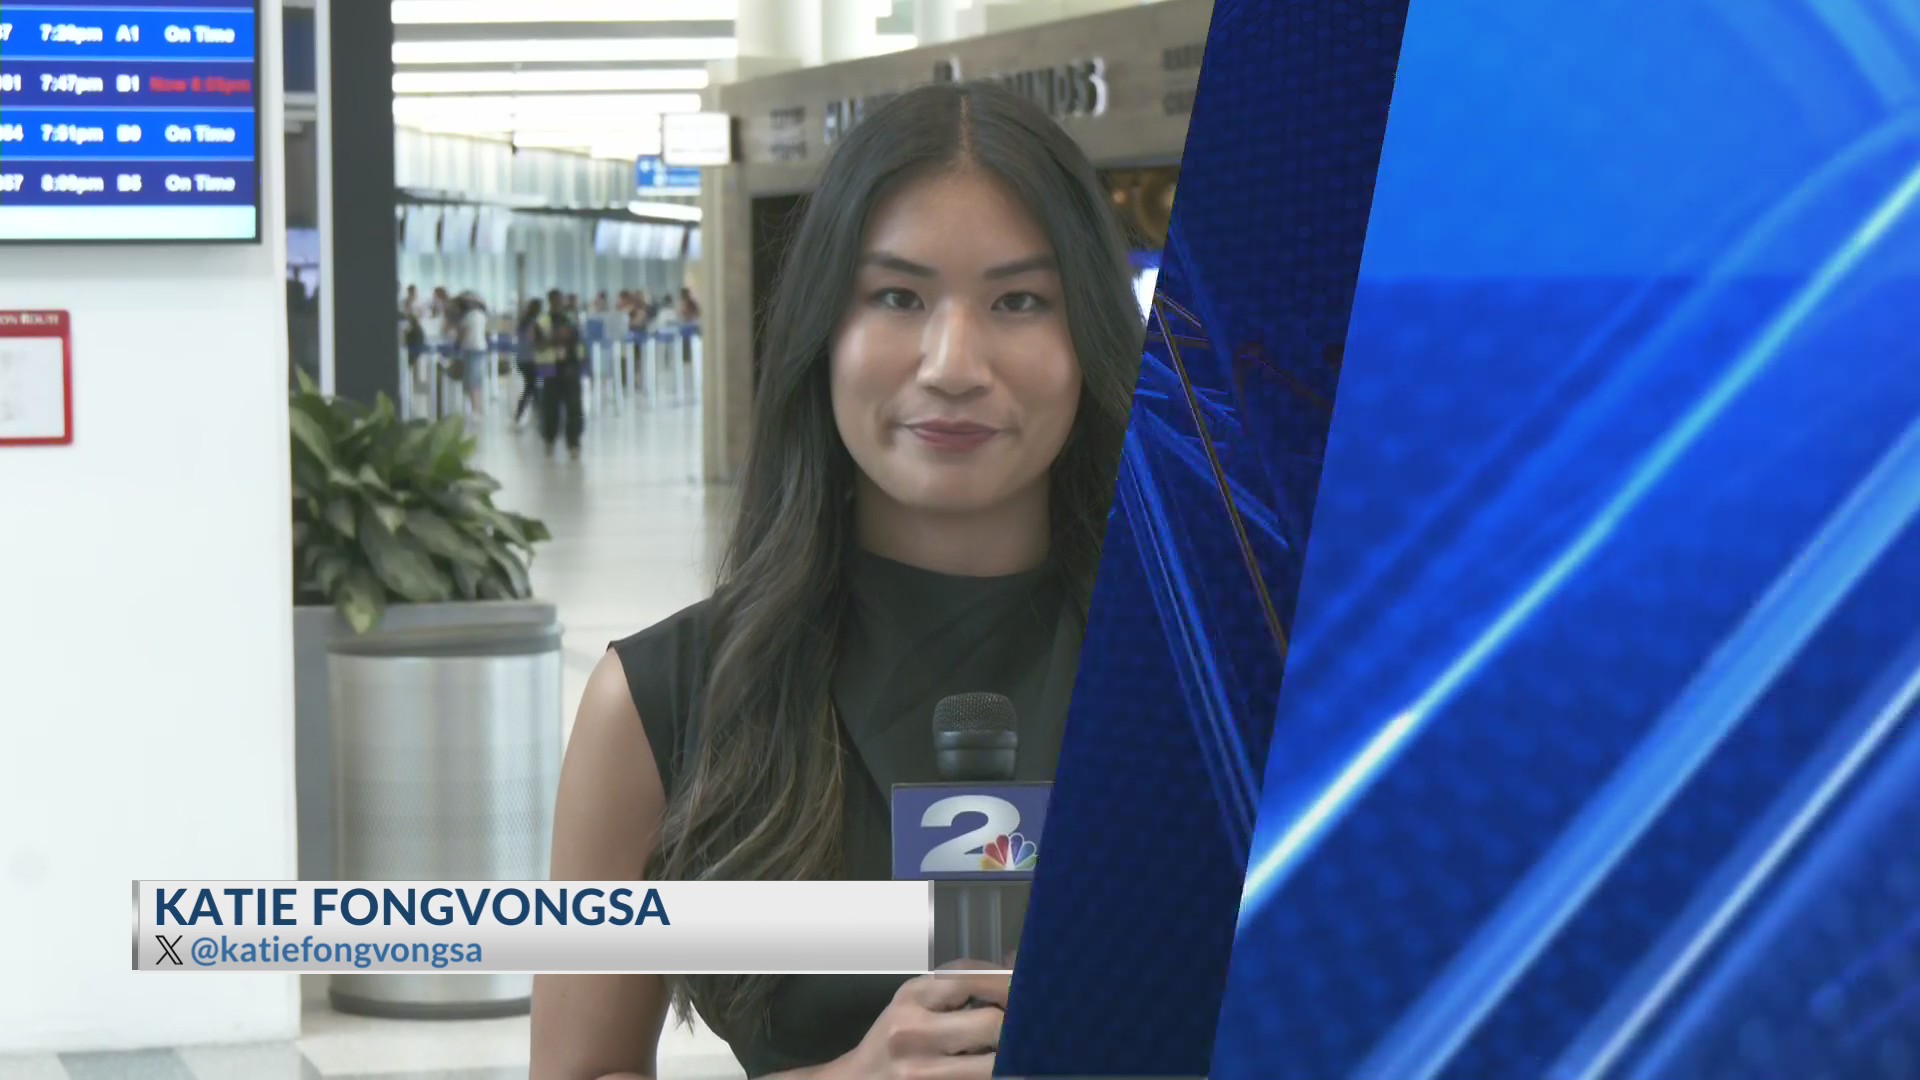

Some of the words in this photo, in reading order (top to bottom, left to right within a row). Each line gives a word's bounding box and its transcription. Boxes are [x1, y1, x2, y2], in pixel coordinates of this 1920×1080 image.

[115, 24, 140, 43] A1
[164, 25, 192, 43] On
[194, 25, 236, 43] Time
[164, 124, 192, 143] On
[194, 124, 236, 143] Time
[164, 173, 192, 192] On
[194, 173, 236, 192] Time
[920, 794, 1021, 873] 2
